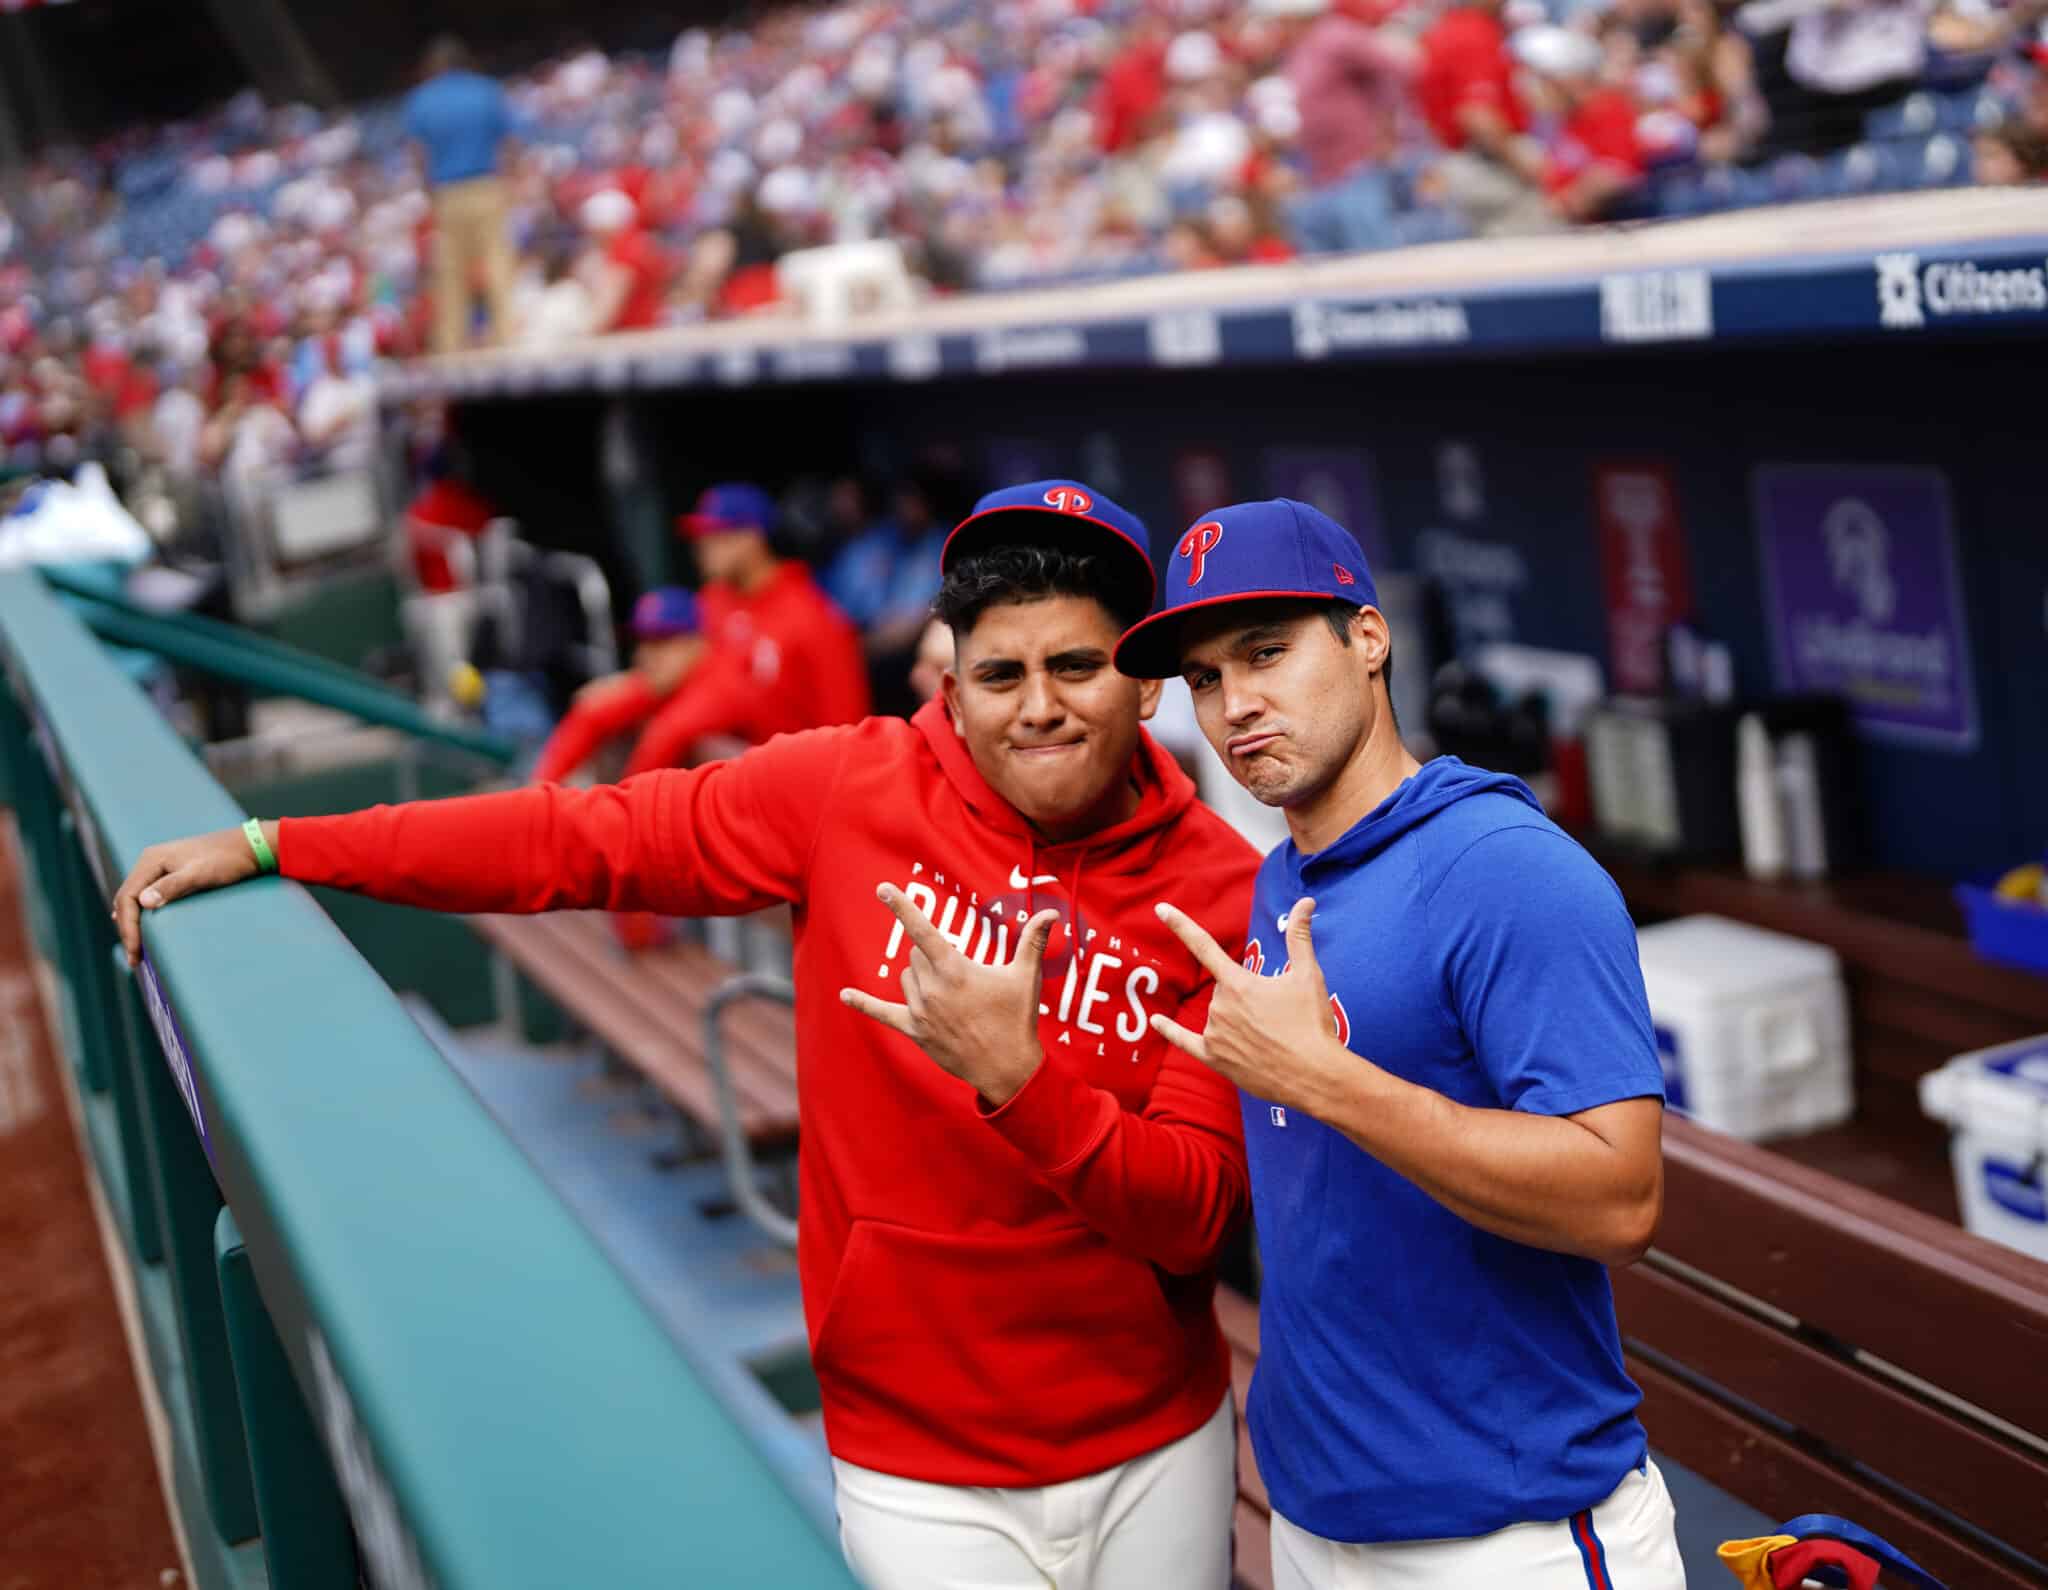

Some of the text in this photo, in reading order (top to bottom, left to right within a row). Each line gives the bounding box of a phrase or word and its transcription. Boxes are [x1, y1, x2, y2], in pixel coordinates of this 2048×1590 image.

[1925, 261, 2046, 316] Citizens
[1044, 485, 1094, 514] P
[1179, 521, 1223, 586] P
